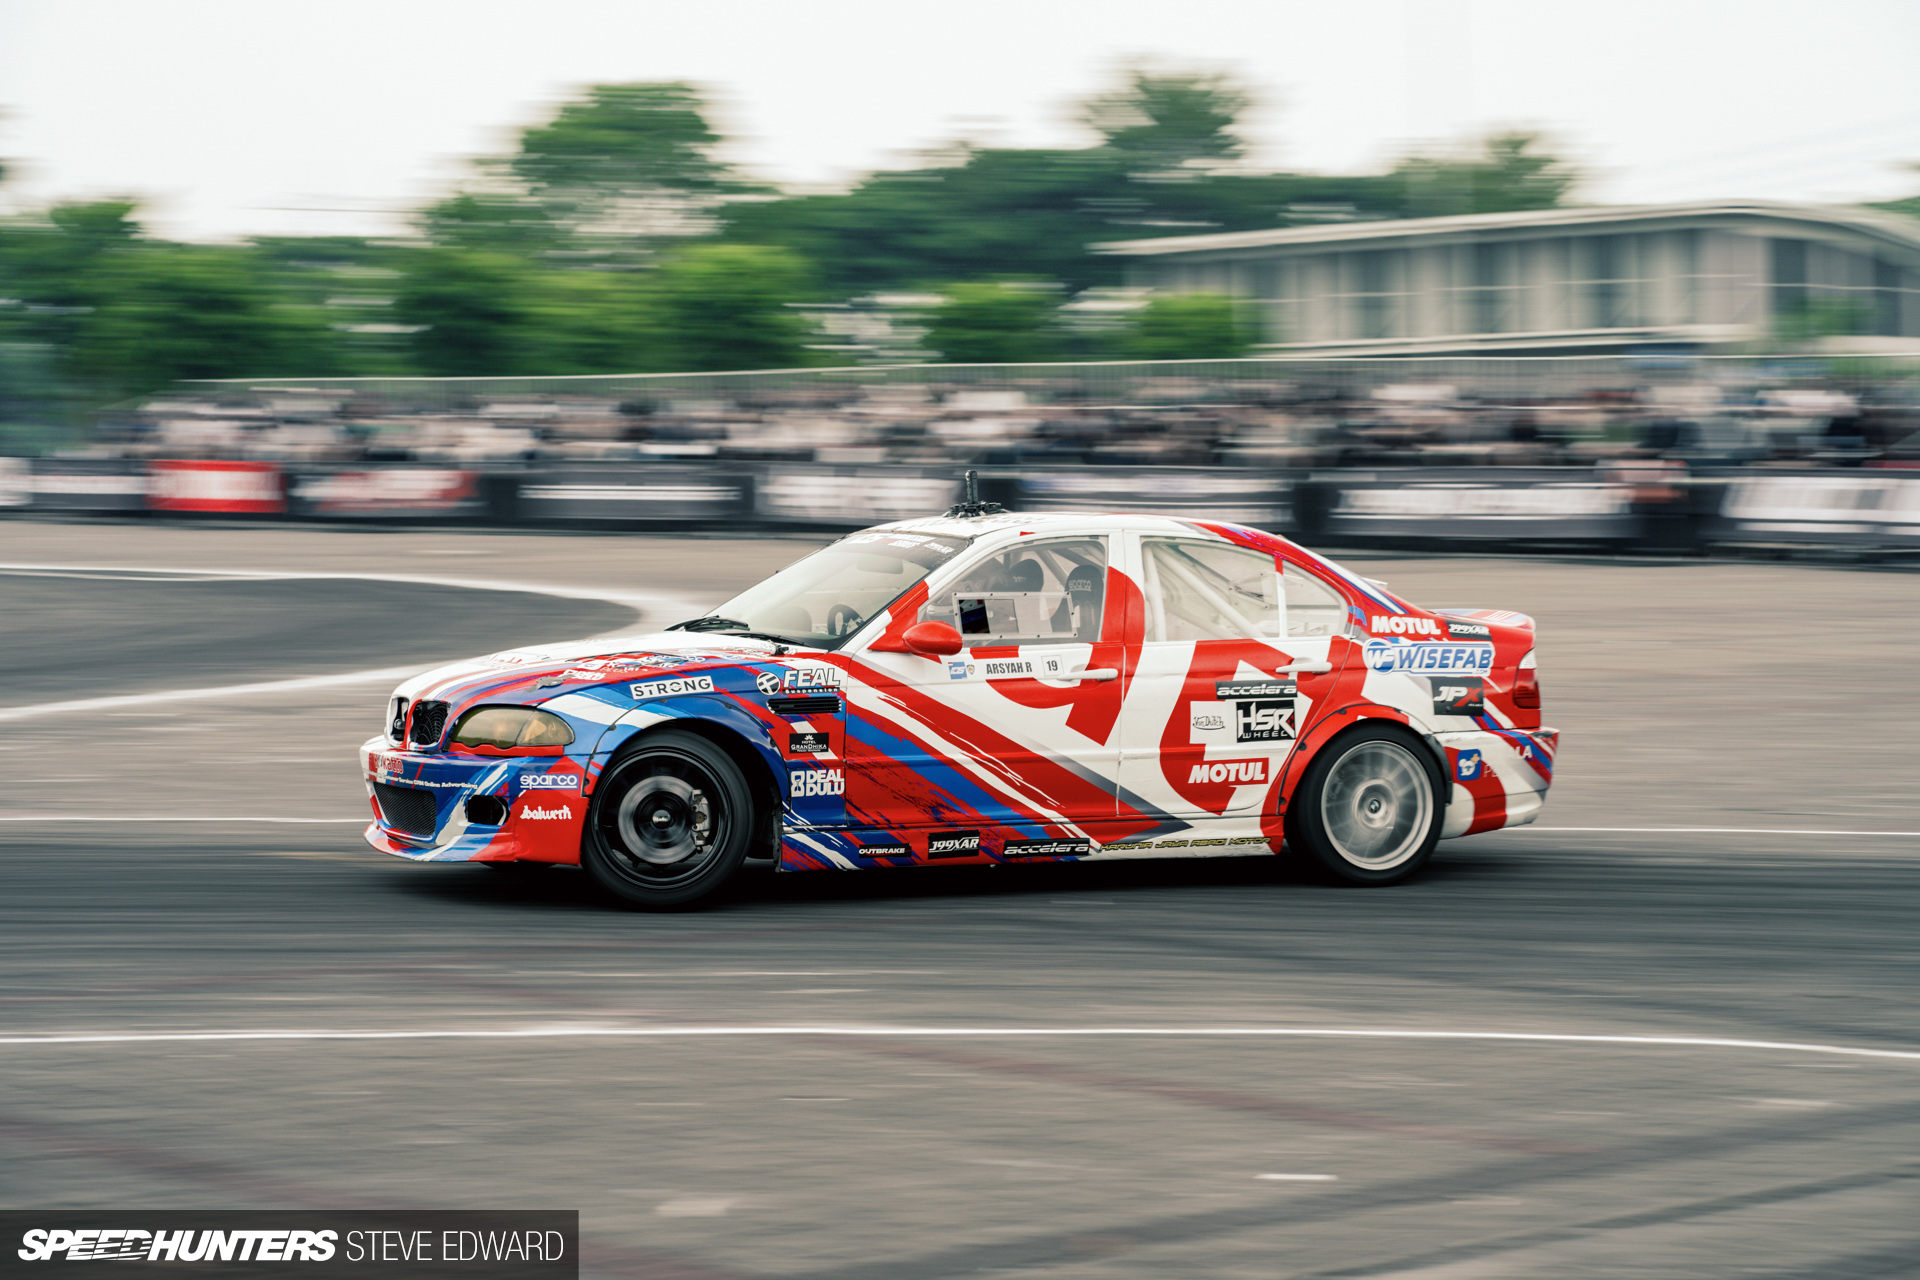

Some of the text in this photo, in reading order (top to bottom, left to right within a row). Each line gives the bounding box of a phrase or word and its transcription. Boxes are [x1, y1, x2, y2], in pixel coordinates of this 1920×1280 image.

[1371, 615, 1441, 635] MOTUL
[1046, 660, 1059, 672] 19
[1399, 648, 1492, 669] WISEFAB
[986, 662, 1033, 674] ARSYAH R
[783, 668, 841, 688] FEAL
[633, 678, 711, 698] STRONG
[784, 687, 838, 695] Suspension
[1216, 684, 1297, 696] accelera
[1433, 686, 1483, 707] JPX
[1237, 701, 1295, 739] HSR
[1242, 730, 1289, 739] WHEEL
[806, 769, 845, 784] DEAL
[1187, 762, 1266, 784] MOTUL
[441, 782, 478, 790] Advertising
[520, 775, 578, 790] sparco
[805, 781, 845, 797] DULU
[858, 847, 905, 855] OUTBRAKE
[1004, 842, 1089, 855] accelera
[1100, 842, 1153, 851] KARUNIA
[1228, 837, 1272, 845] MOTOR
